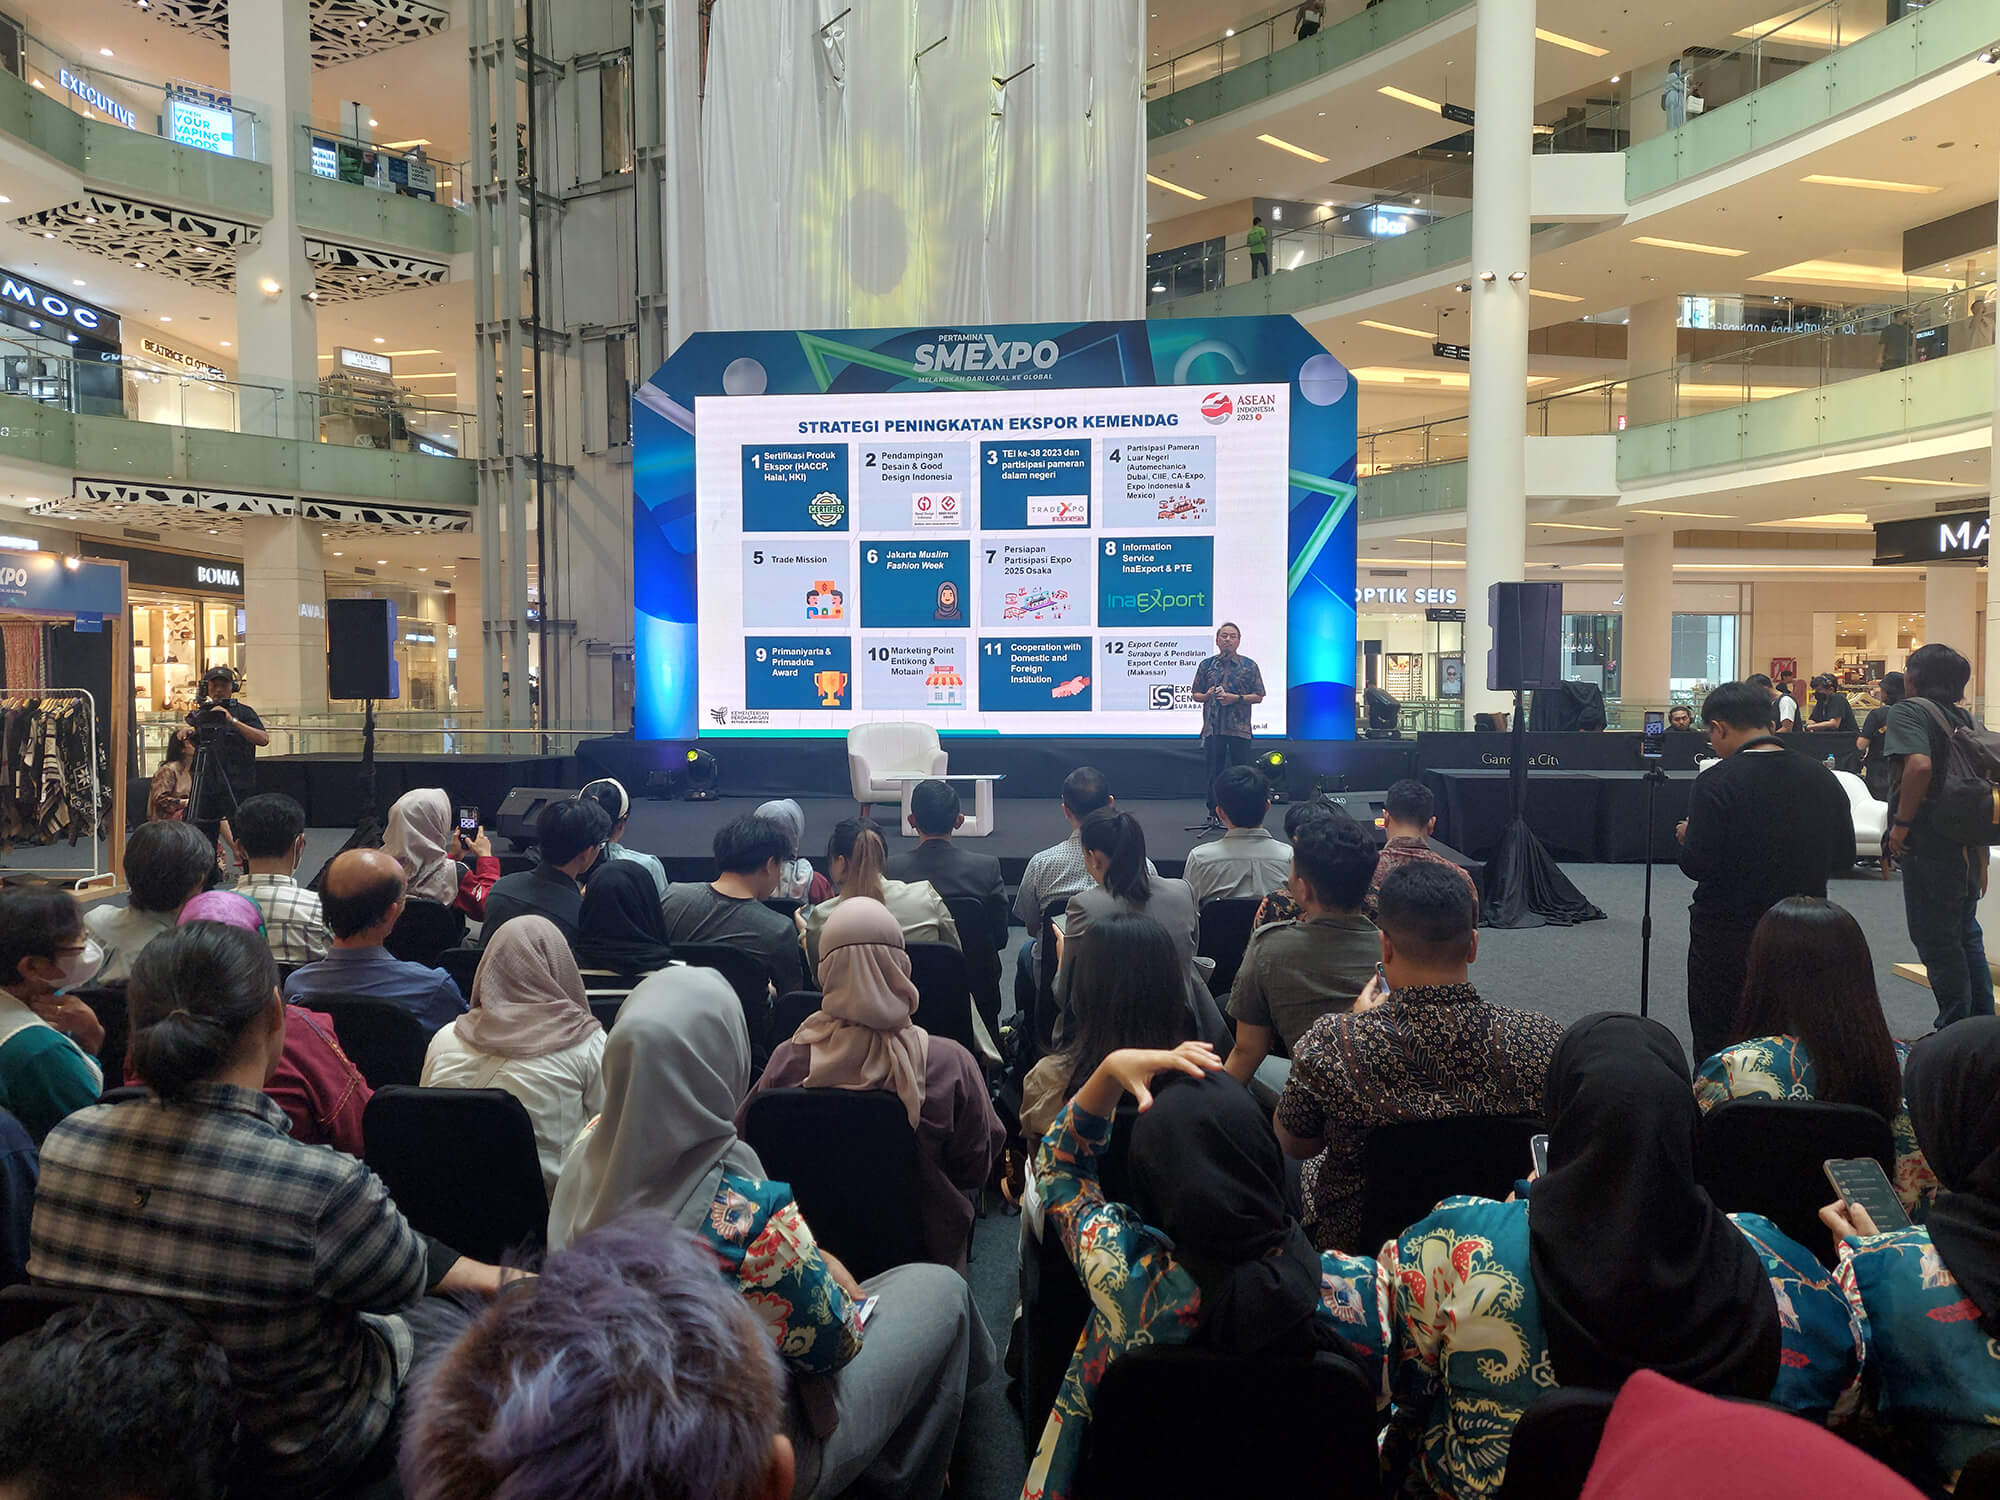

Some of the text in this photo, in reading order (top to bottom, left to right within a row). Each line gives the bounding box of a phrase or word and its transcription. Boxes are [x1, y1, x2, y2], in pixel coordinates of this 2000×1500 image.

[60, 68, 136, 130] EXECUTIVE
[176, 114, 210, 129] YOUR
[175, 125, 220, 142] VAPING
[175, 135, 219, 151] MOODS
[1, 279, 99, 329] MOC
[938, 334, 984, 342] PERTAMINA
[143, 339, 184, 365] BEATRICE
[912, 334, 1059, 372] SMEXPO
[1237, 395, 1275, 405] ASEAN
[798, 413, 1178, 433] STRATEGI PENINGKATAN EKSPOR KEMENDAG
[764, 452, 805, 460] Sertifikasi
[882, 452, 944, 461] Pendampingan
[987, 450, 998, 464] 3
[1018, 449, 1040, 457] ke-38
[1110, 449, 1121, 463] 4
[1146, 454, 1169, 462] Negeri
[751, 454, 760, 469] 1
[865, 453, 876, 467] 2
[764, 462, 829, 472] Ekspor (HACCP,
[920, 462, 943, 470] Good
[1002, 461, 1085, 470] partisipasi pameran
[1127, 464, 1186, 472] (Automechanica
[764, 473, 806, 482] Halal, HKI)
[882, 473, 953, 482] Design Indonesia
[1029, 471, 1056, 480] negeri
[1127, 473, 1150, 481] Dubai,
[1127, 483, 1146, 491] Expo
[1004, 546, 1046, 554] Persiapan
[1105, 541, 1116, 556] 8
[1122, 543, 1172, 551] Information
[753, 551, 764, 564] 5
[867, 549, 878, 563] 6
[986, 550, 996, 564] 7
[1004, 556, 1072, 565] Partisipasi Expo
[1122, 554, 1155, 562] Service
[1122, 564, 1192, 574] InaExport & PTE
[198, 565, 240, 586] BONIA
[1108, 587, 1205, 613] InaExport
[1415, 588, 1457, 603] SEIS
[984, 642, 1001, 656] 11
[1011, 643, 1081, 653] Cooperation with
[1105, 642, 1124, 654] 12
[1127, 641, 1152, 649] Export
[756, 648, 767, 662] 9
[772, 647, 824, 657] Primaniyarta
[868, 647, 889, 661] 10
[891, 647, 931, 656] Marketing
[1127, 650, 1161, 658] Surabaya
[772, 658, 814, 666] Primaduta
[891, 657, 927, 666] Entikong
[1011, 654, 1050, 662] Domestic
[1011, 664, 1043, 674] Foreign
[1127, 660, 1151, 668] Export
[1011, 675, 1052, 683] Institution
